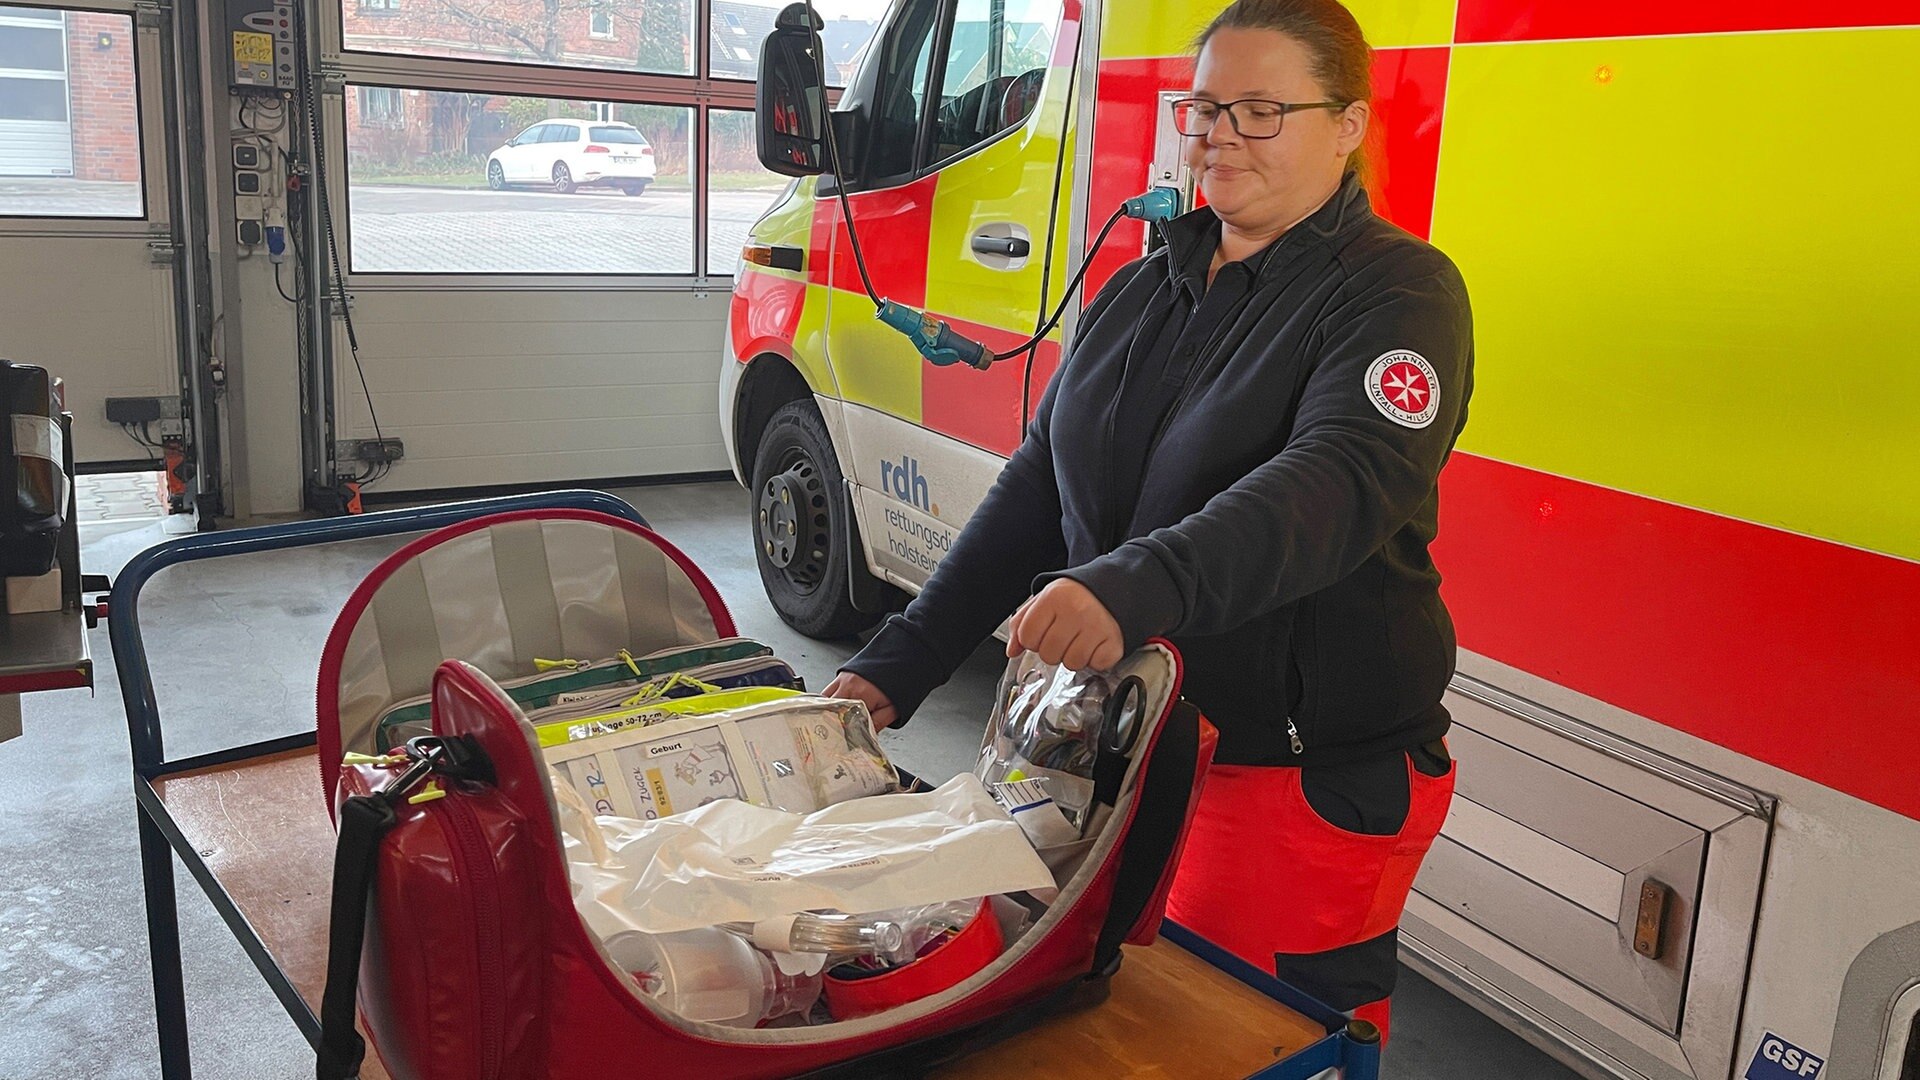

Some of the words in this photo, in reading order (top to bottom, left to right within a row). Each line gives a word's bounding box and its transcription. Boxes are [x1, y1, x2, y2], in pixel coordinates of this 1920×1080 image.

[625, 714, 647, 726] 50-72
[650, 742, 682, 755] Geburt
[1762, 1039, 1820, 1077] GSF
